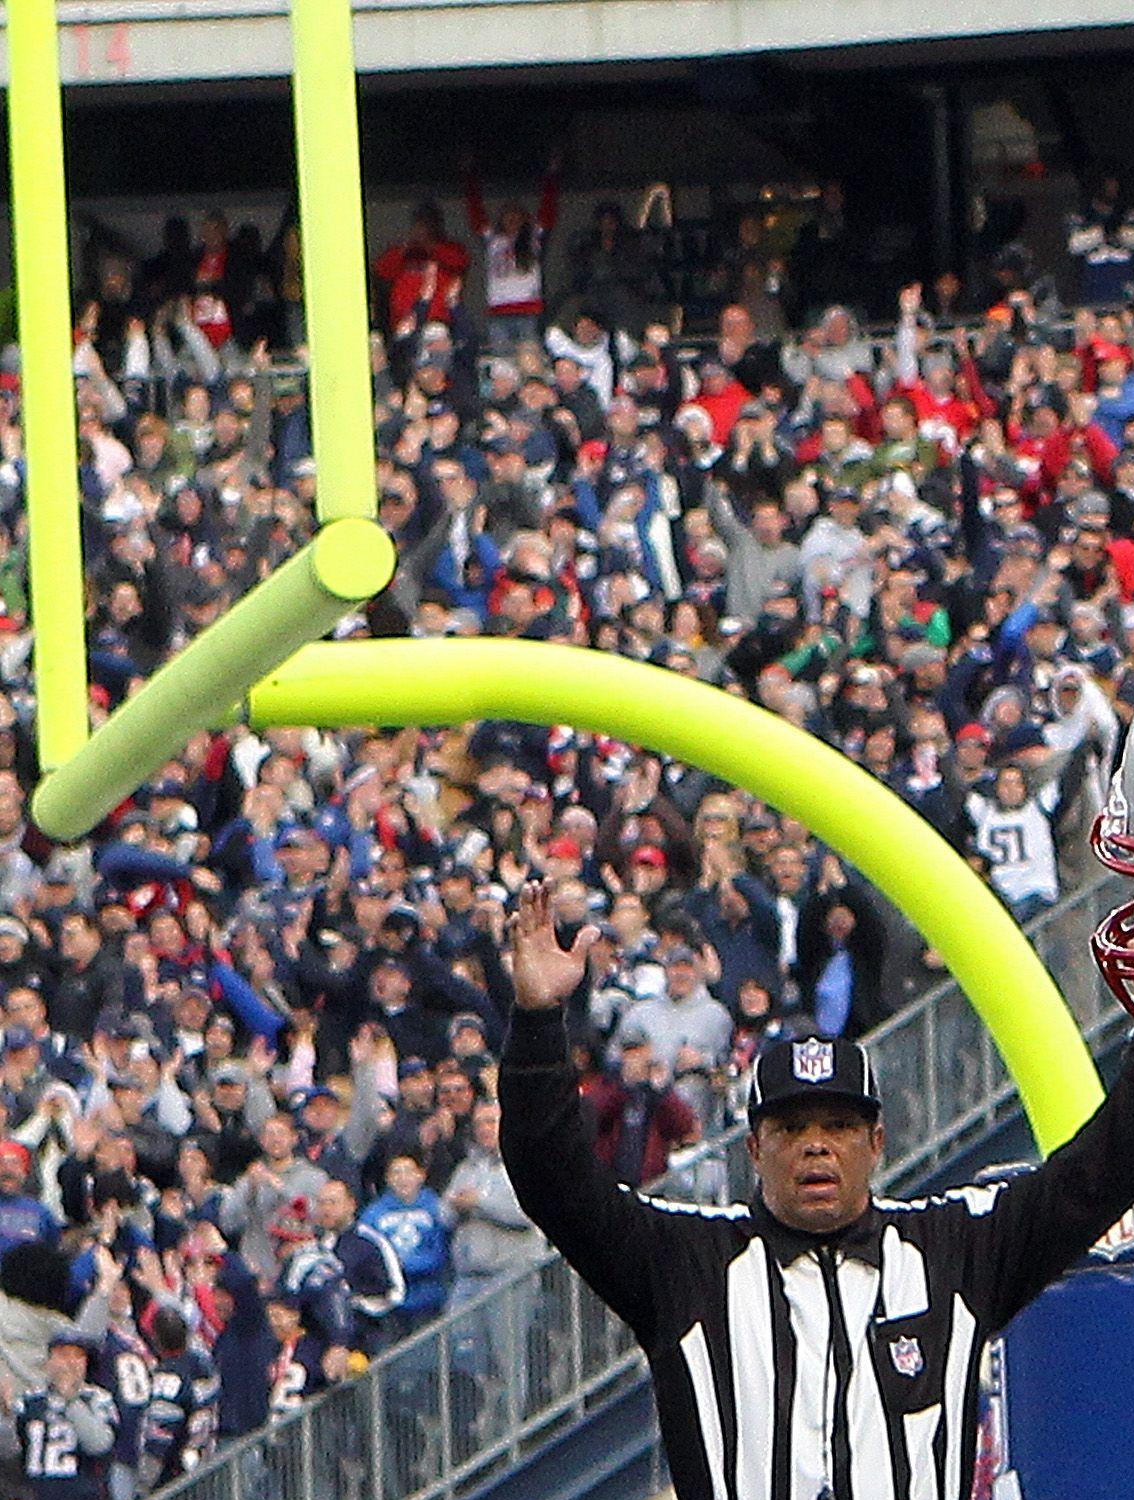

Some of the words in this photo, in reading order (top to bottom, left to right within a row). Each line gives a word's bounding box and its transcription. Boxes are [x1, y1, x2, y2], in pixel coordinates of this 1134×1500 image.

[73, 24, 131, 75] 14
[989, 823, 1029, 864] 51
[26, 1419, 79, 1475] 12
